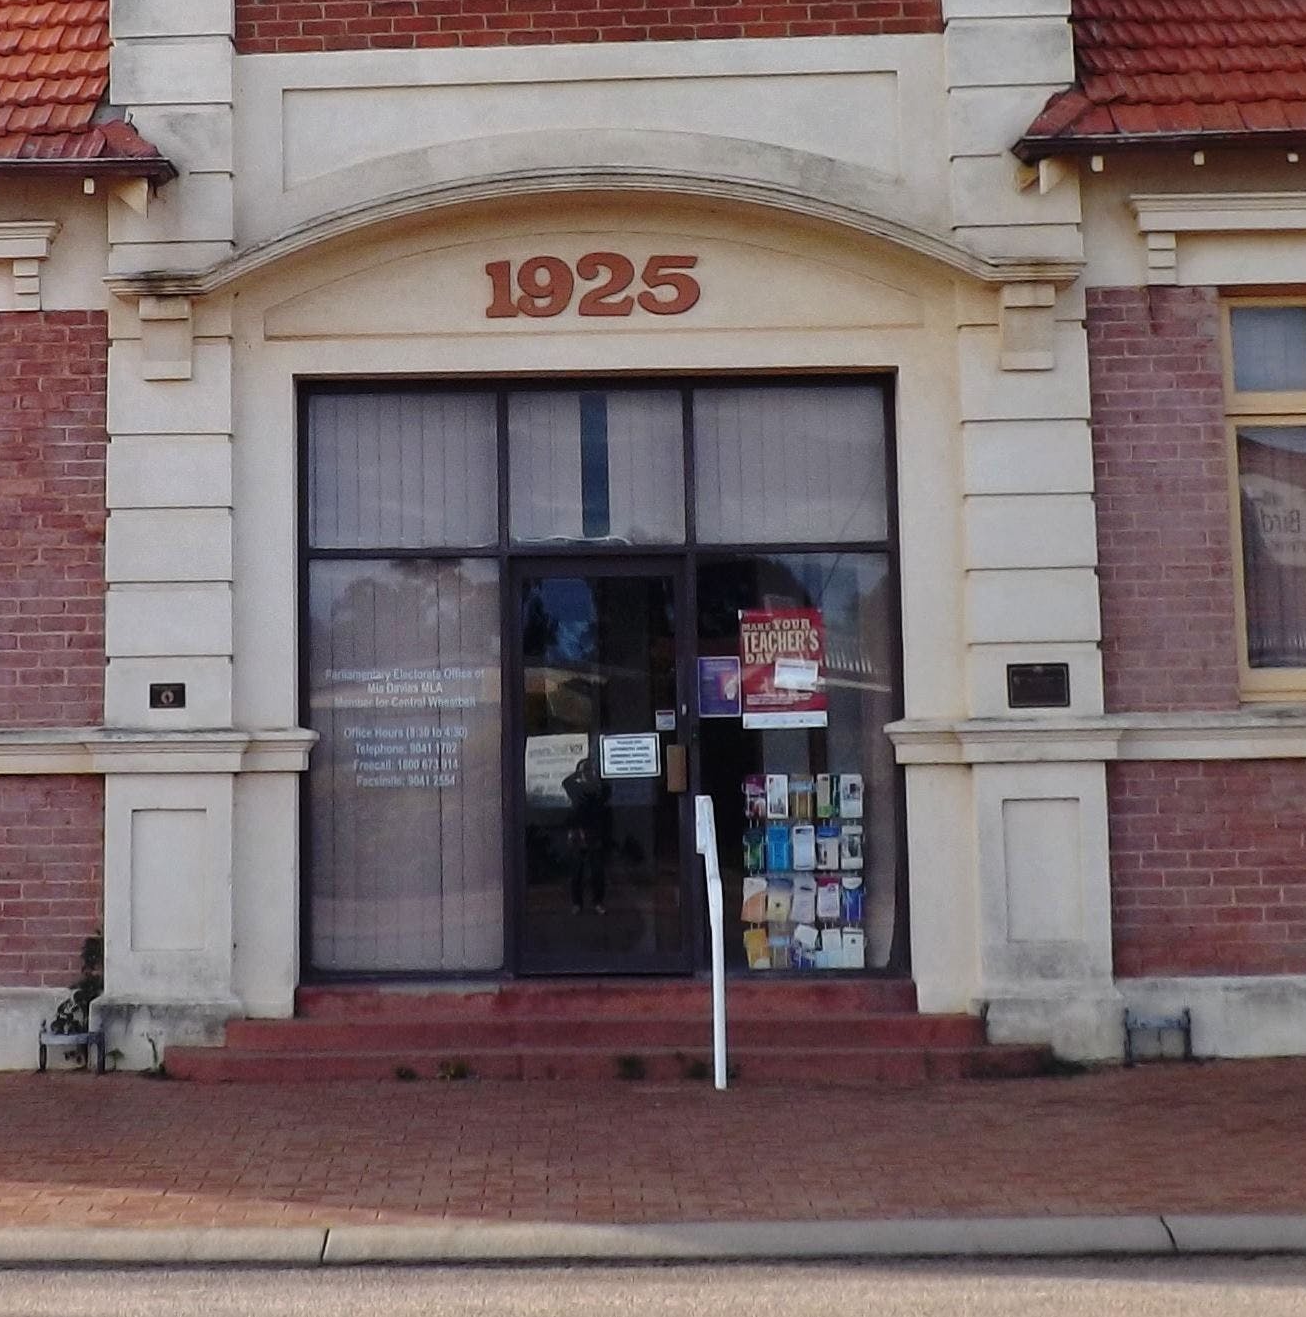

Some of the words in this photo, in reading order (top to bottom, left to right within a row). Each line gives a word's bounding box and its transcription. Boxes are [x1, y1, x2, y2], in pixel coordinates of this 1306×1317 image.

[485, 251, 701, 318] 1925
[742, 629, 820, 653] TEACHER'S
[421, 681, 443, 693] MLA
[344, 727, 371, 739] Office
